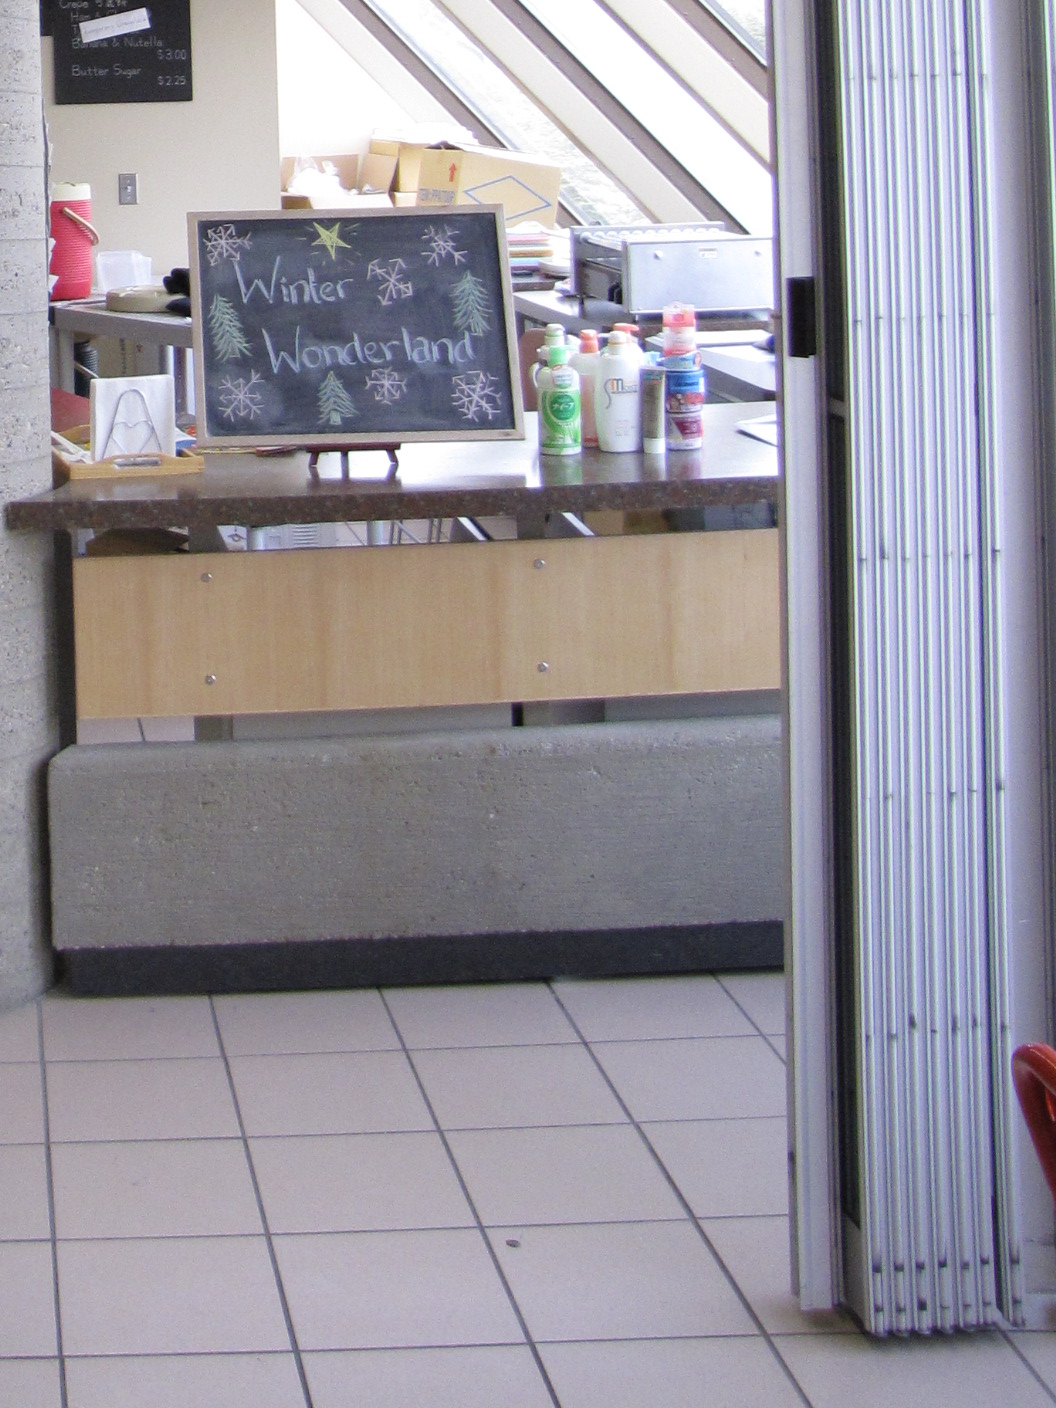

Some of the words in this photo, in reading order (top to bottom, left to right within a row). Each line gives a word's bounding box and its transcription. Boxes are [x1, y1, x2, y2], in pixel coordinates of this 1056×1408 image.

[123, 35, 163, 48] Nutella
[71, 64, 109, 77] Butter
[112, 63, 142, 79] Sugar
[157, 75, 187, 86] $2.25
[232, 255, 354, 305] Winter
[261, 325, 477, 374] Wonderland
